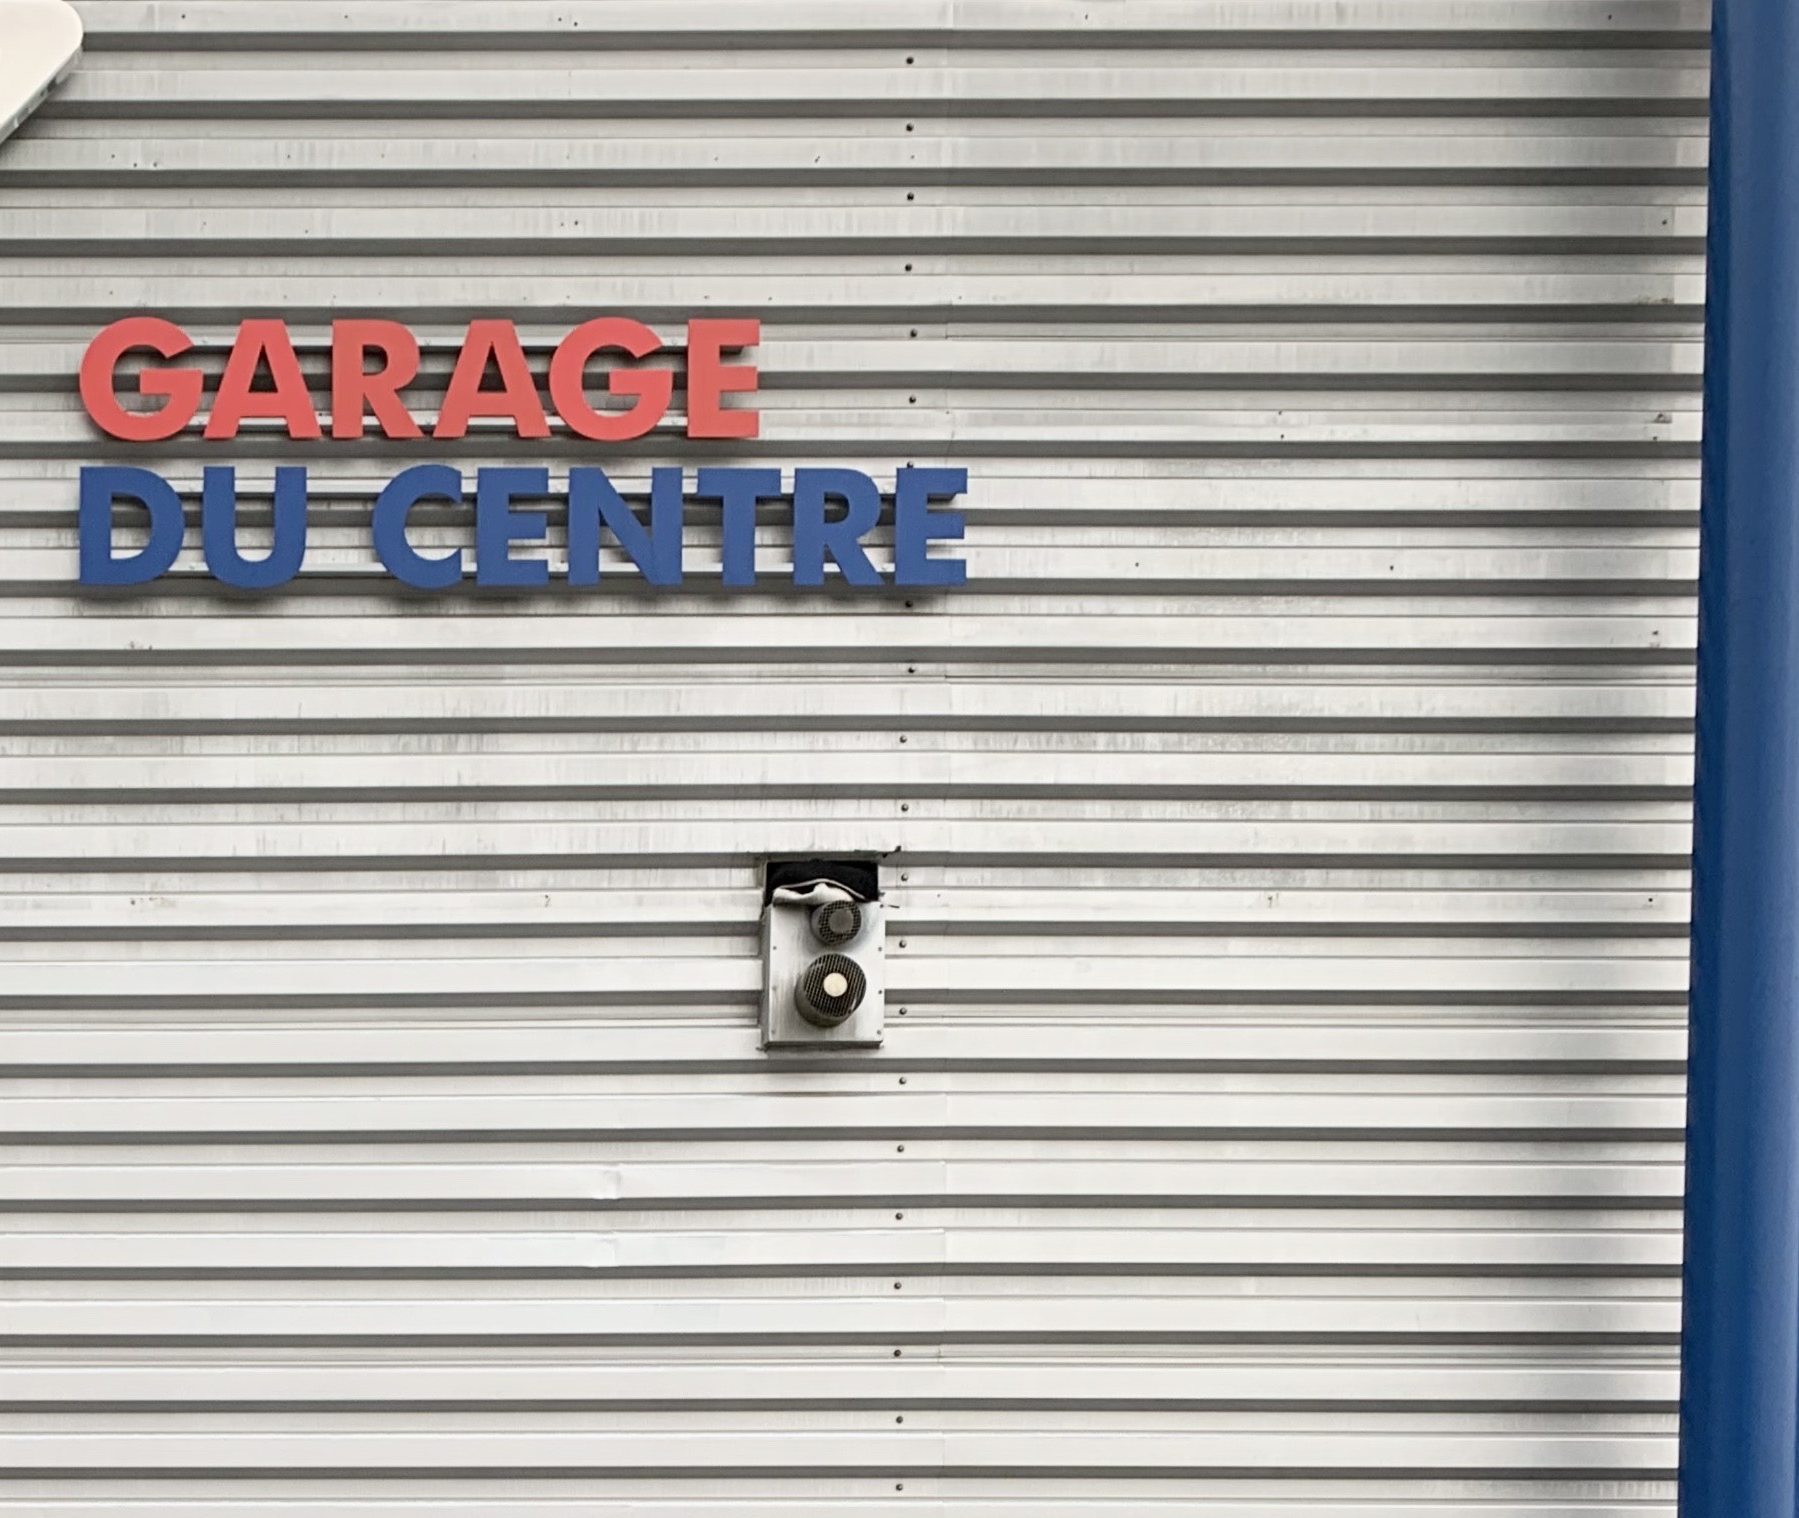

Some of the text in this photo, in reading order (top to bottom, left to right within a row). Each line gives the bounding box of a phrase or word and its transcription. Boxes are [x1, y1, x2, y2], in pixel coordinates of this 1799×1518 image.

[79, 317, 760, 441] GARAGE
[80, 465, 966, 588] DU CENTRE
